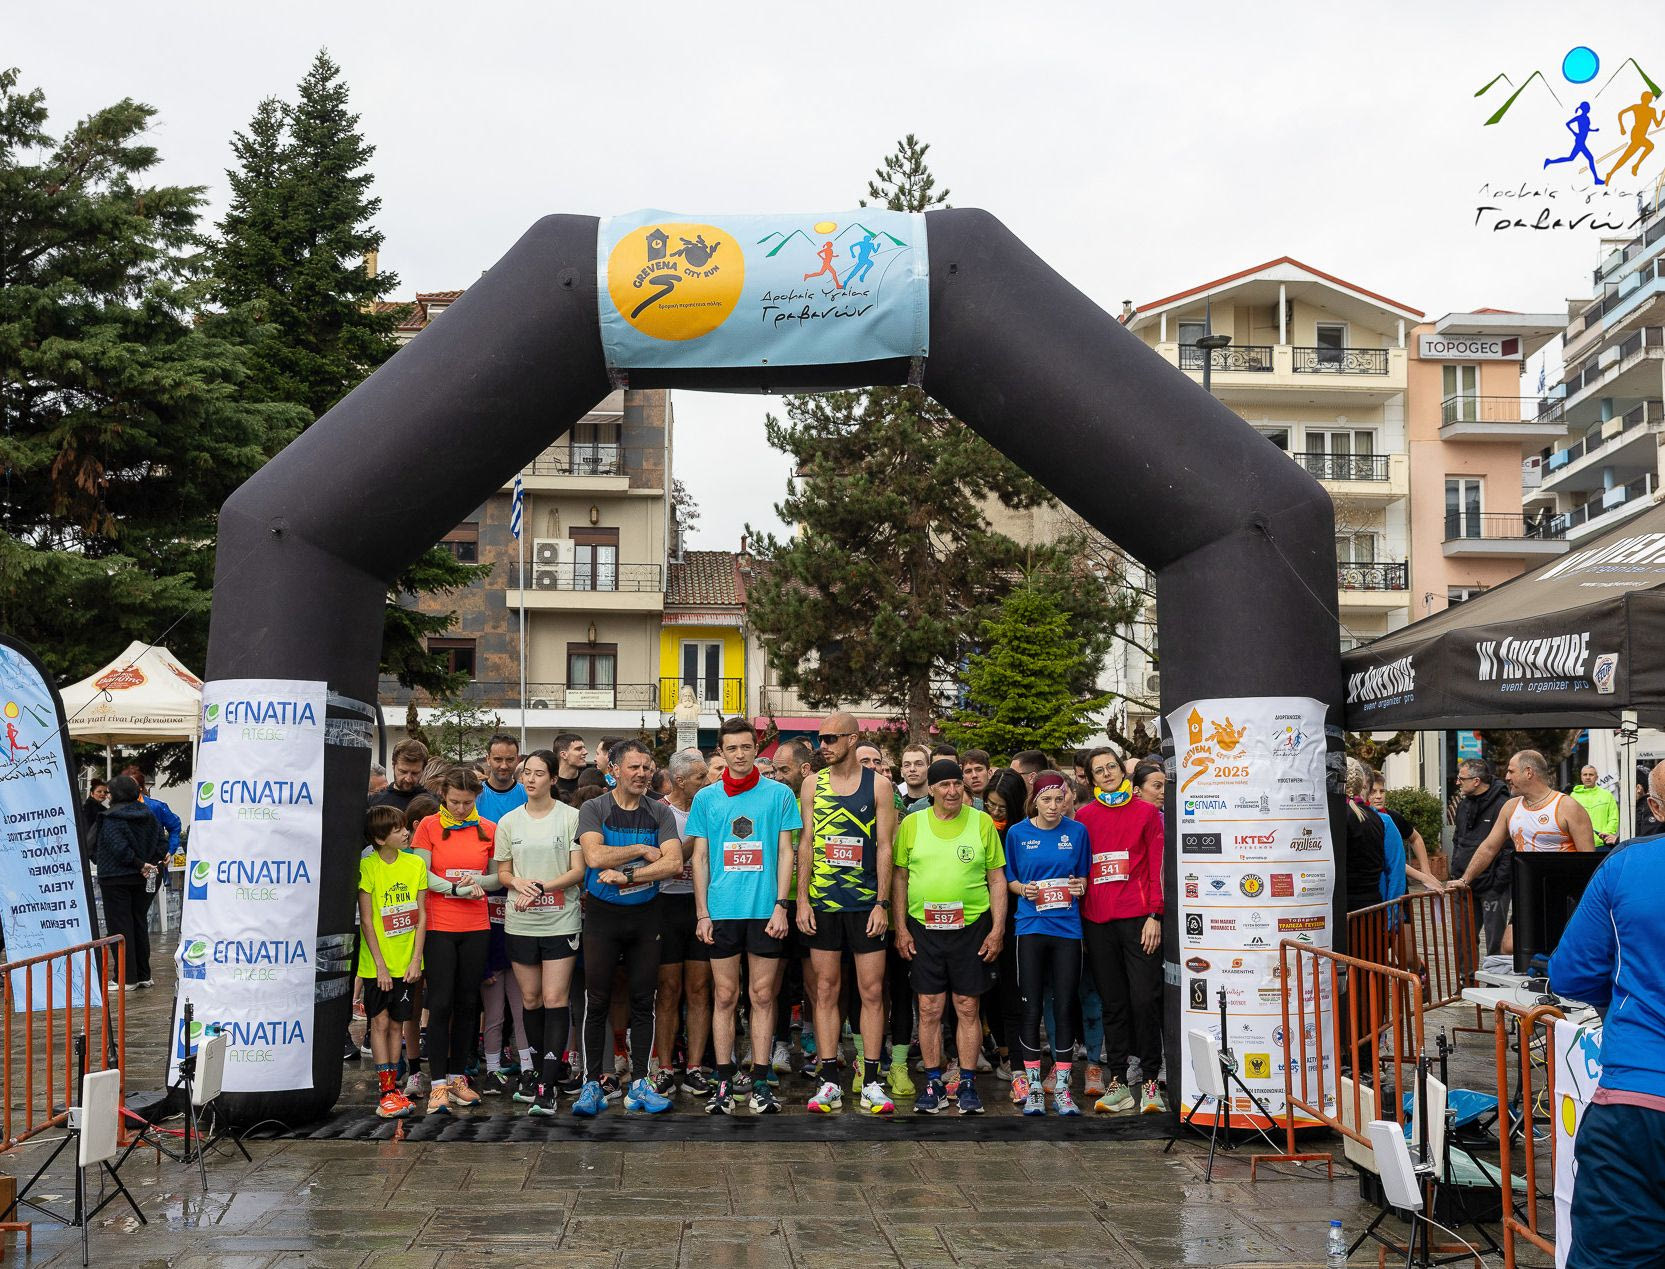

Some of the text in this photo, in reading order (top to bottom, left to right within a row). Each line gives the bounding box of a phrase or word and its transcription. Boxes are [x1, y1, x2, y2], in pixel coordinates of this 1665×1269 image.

[632, 261, 678, 288] GREVENA
[684, 265, 720, 278] CITY RUN
[762, 304, 874, 328] Γρεβενών
[1426, 342, 1498, 354] TOPOGEC
[1476, 632, 1590, 680] MY ADVENTURE
[1347, 656, 1415, 704] MY ADVENTURE
[1501, 680, 1590, 692] event organizer pro
[1364, 694, 1414, 710] event organizer pro
[226, 701, 316, 726] ΕΓΝΑΤΙΑ
[1182, 745, 1212, 768] GREVENA
[1214, 766, 1250, 778] 2025
[220, 780, 314, 804] ΕΓΝΑΤΙΑ
[1195, 800, 1227, 810] ΕΓΝΑΤΙΑ
[733, 854, 752, 864] 547
[833, 848, 852, 859] 504
[216, 860, 311, 884] ΕΓΝΑΤΙΑ
[1101, 864, 1120, 875] 541
[396, 892, 410, 902] RUN
[1044, 892, 1064, 902] 528
[392, 916, 412, 928] 536
[934, 914, 954, 923] 587
[214, 940, 308, 964] ΕΓΝΑΤΙΑ
